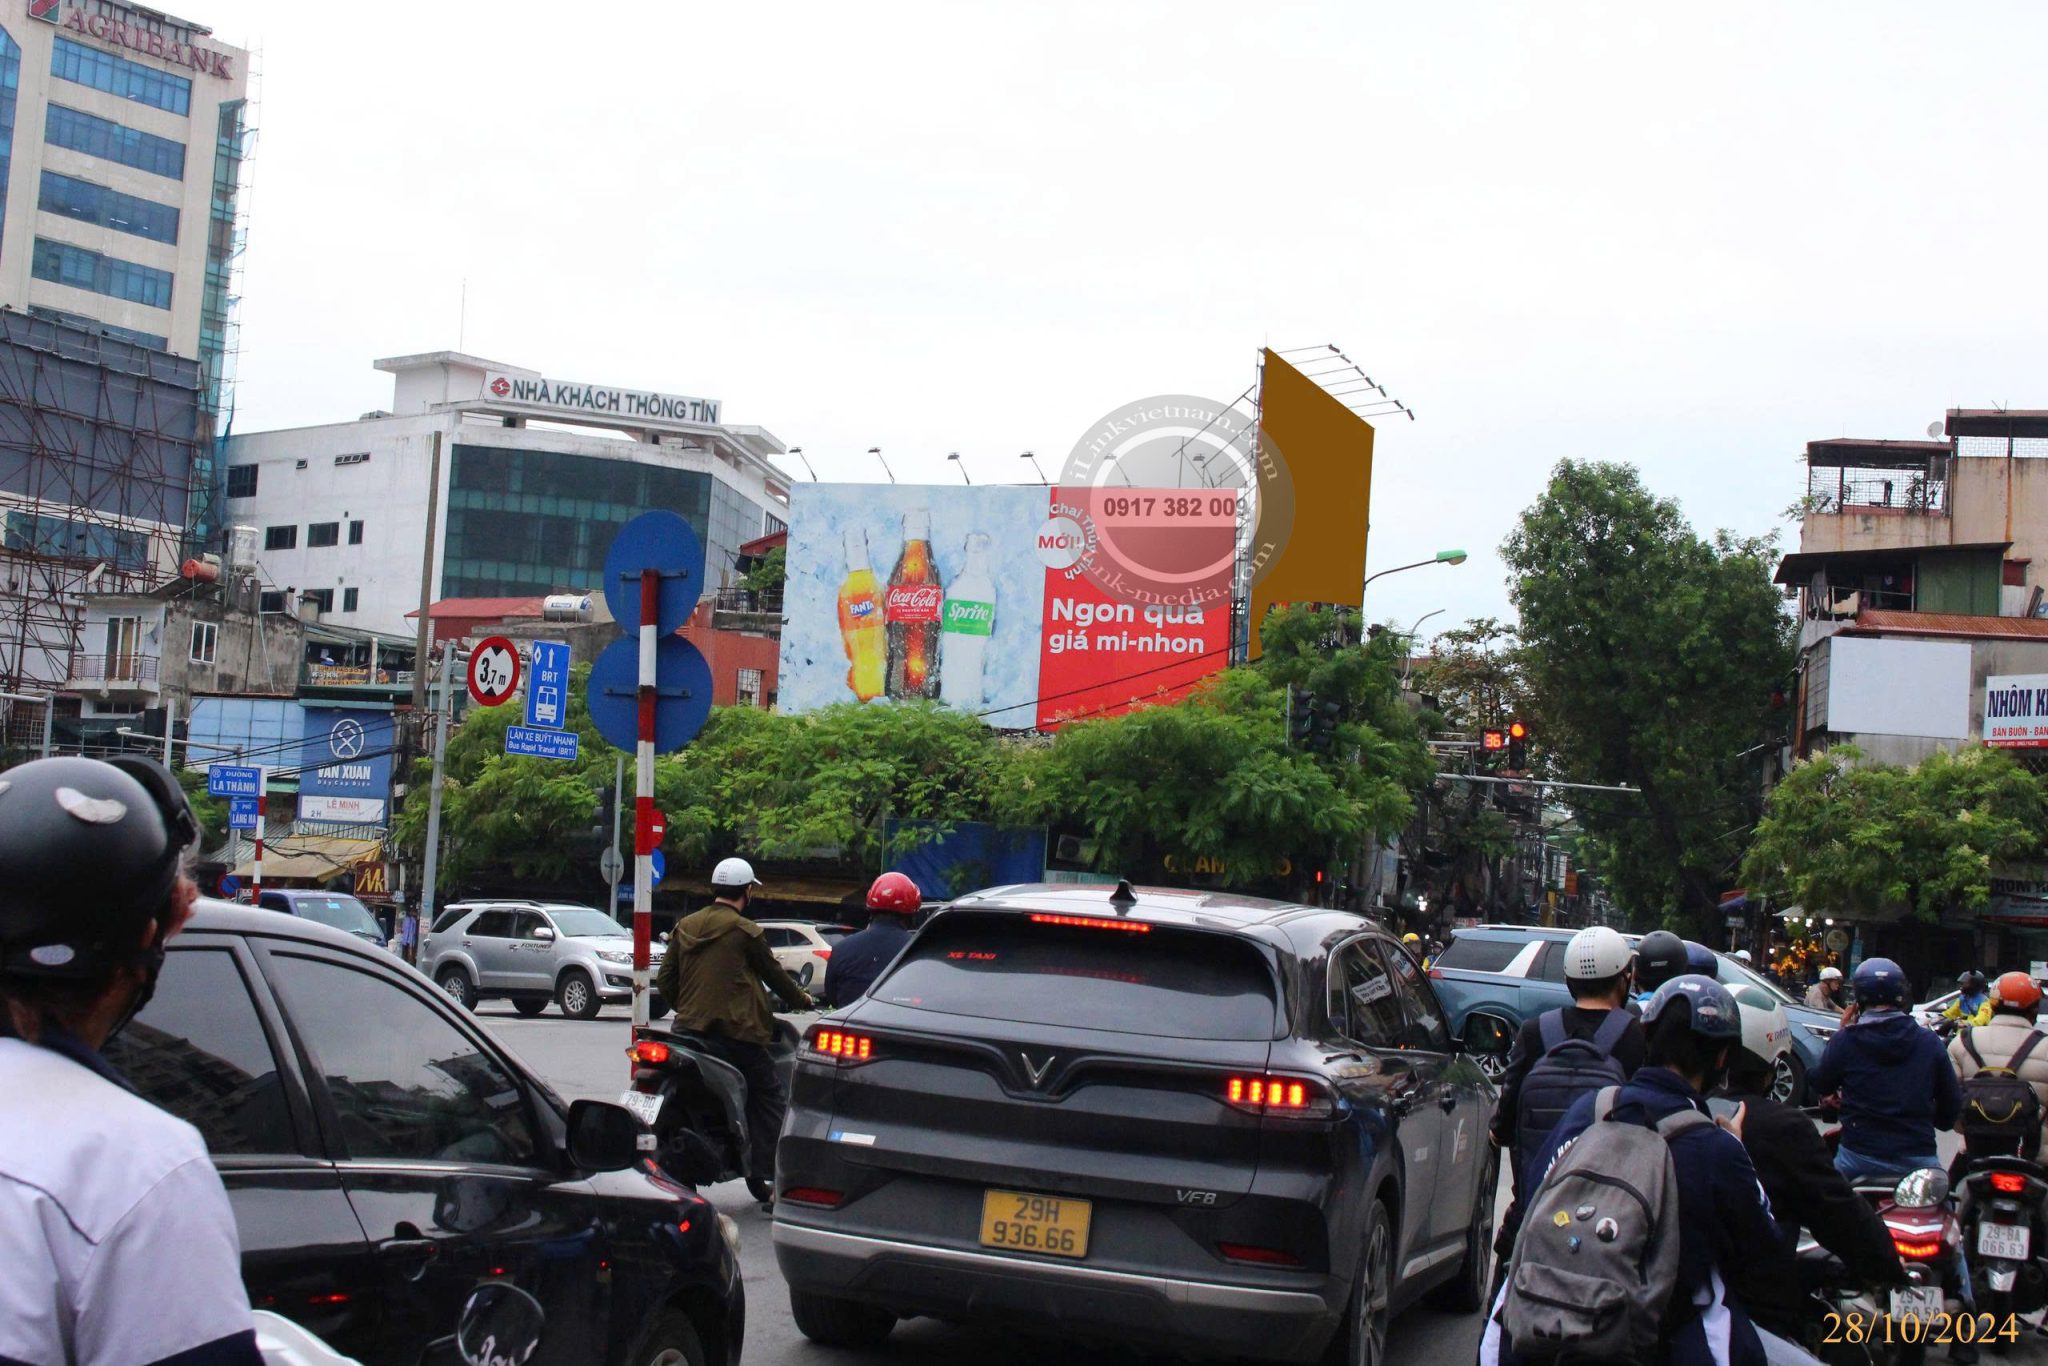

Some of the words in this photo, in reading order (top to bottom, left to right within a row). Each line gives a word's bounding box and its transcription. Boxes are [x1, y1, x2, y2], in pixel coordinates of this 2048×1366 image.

[63, 7, 234, 81] AGRIBANK
[512, 379, 551, 402] NHÀ
[554, 384, 620, 412] KHÁCH
[625, 393, 687, 419] THÔNG
[888, 588, 938, 608] Coca-Cola
[948, 602, 990, 621] Sprite
[1051, 597, 1134, 626] Ngon
[1143, 598, 1205, 629] quá
[1049, 629, 1089, 653] giá
[1096, 631, 1204, 654] mi-nhon
[541, 670, 559, 683] BRT
[1988, 684, 2033, 717] NHÔM
[508, 742, 520, 750] Bus
[521, 743, 536, 753] Rapid
[538, 744, 556, 754] Transit
[558, 746, 575, 756] (BRT)
[525, 732, 534, 741] XE
[553, 735, 576, 747] NHANH
[1485, 733, 1501, 748] 36
[213, 780, 224, 791] LA
[339, 801, 360, 809] MINH
[1014, 1196, 1061, 1224] 29H
[991, 1221, 1076, 1252] 936.66
[1981, 1241, 2026, 1258] 066.63
